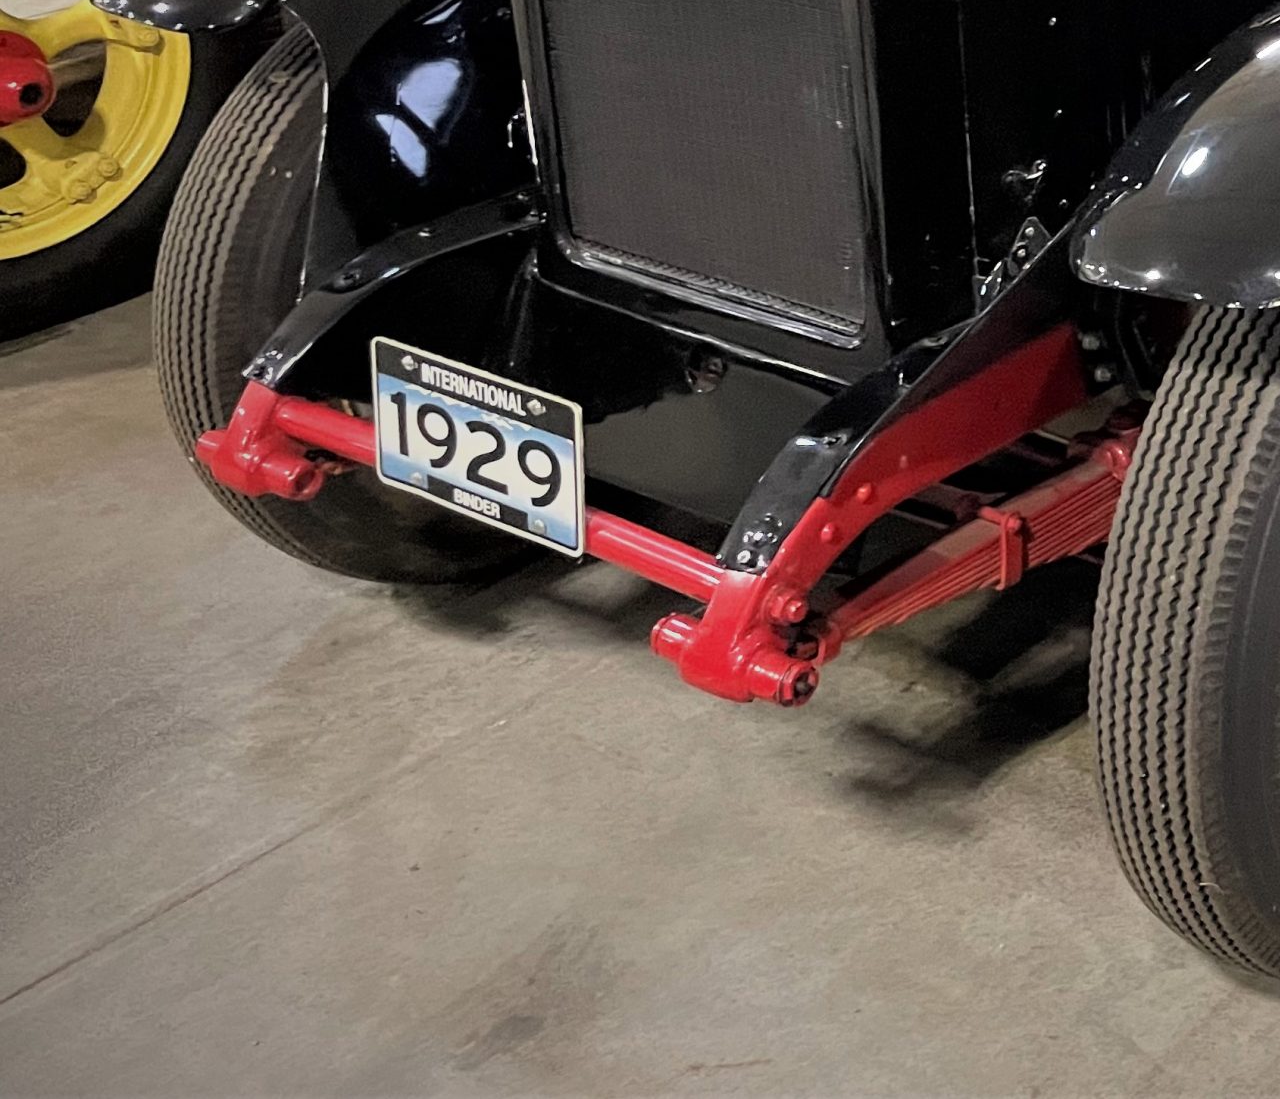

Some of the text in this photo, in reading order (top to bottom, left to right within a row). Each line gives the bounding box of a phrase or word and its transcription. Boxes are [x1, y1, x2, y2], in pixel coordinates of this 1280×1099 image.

[421, 362, 527, 417] INTERNATIONAL
[390, 391, 562, 508] 1929
[453, 487, 501, 519] BINDER
